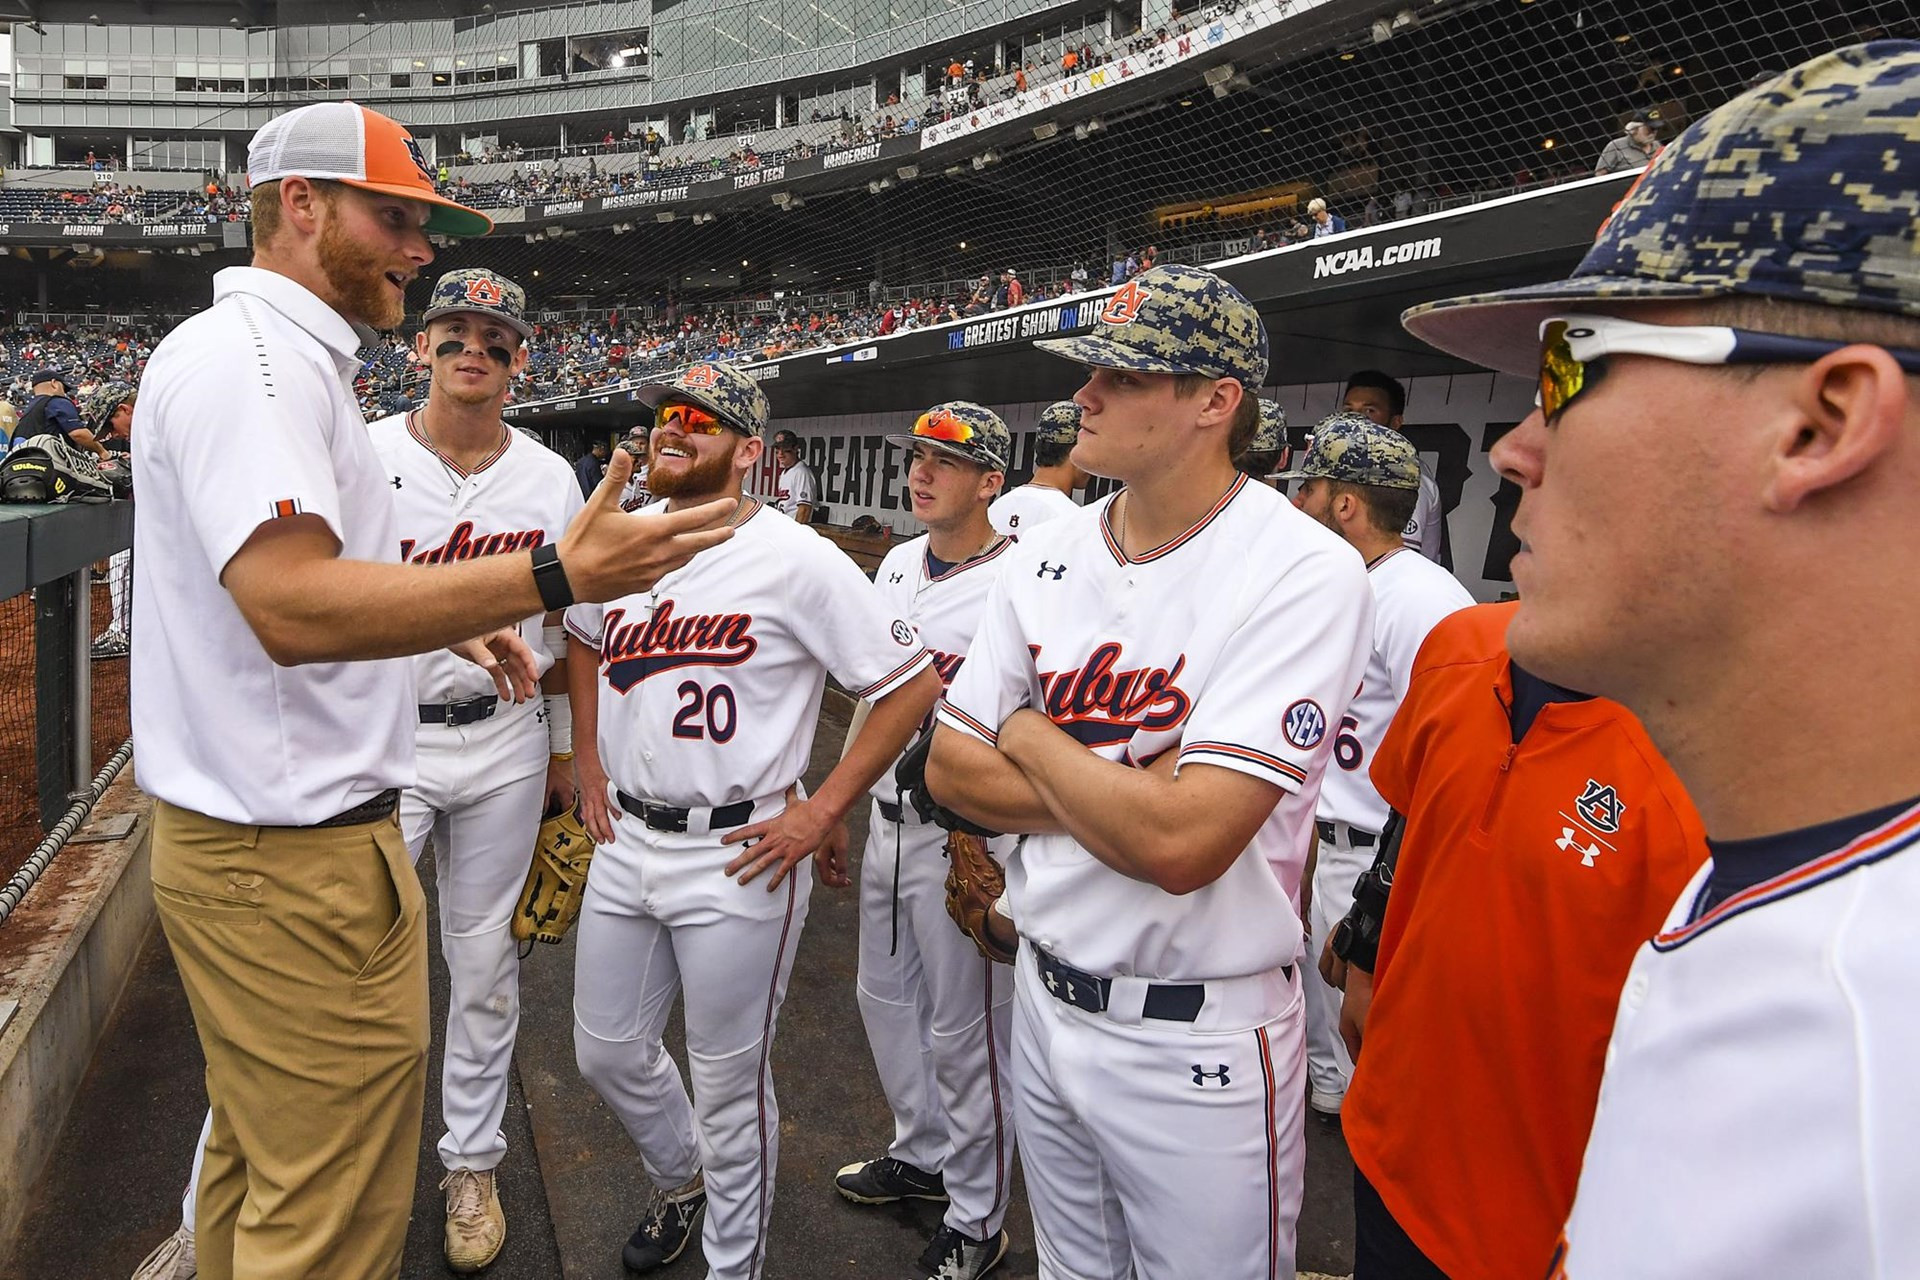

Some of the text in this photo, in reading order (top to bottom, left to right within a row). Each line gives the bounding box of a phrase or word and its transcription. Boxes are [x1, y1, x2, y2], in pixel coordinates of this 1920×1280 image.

[823, 143, 882, 169] VANDERBILT
[97, 173, 112, 181] 210
[733, 166, 785, 189] TEXAS TECH
[544, 201, 584, 217] MICHIGAN
[602, 186, 689, 209] MISSISSIPPI STATE
[62, 225, 104, 236] AUBURN
[142, 224, 207, 236] FLORIDA STATE
[1313, 237, 1442, 279] NCAA.com
[948, 298, 1112, 350] THE GREATEST SHOW ON DIR
[600, 599, 757, 668] Auburn
[672, 680, 737, 744] 20
[1285, 702, 1324, 747] SEC
